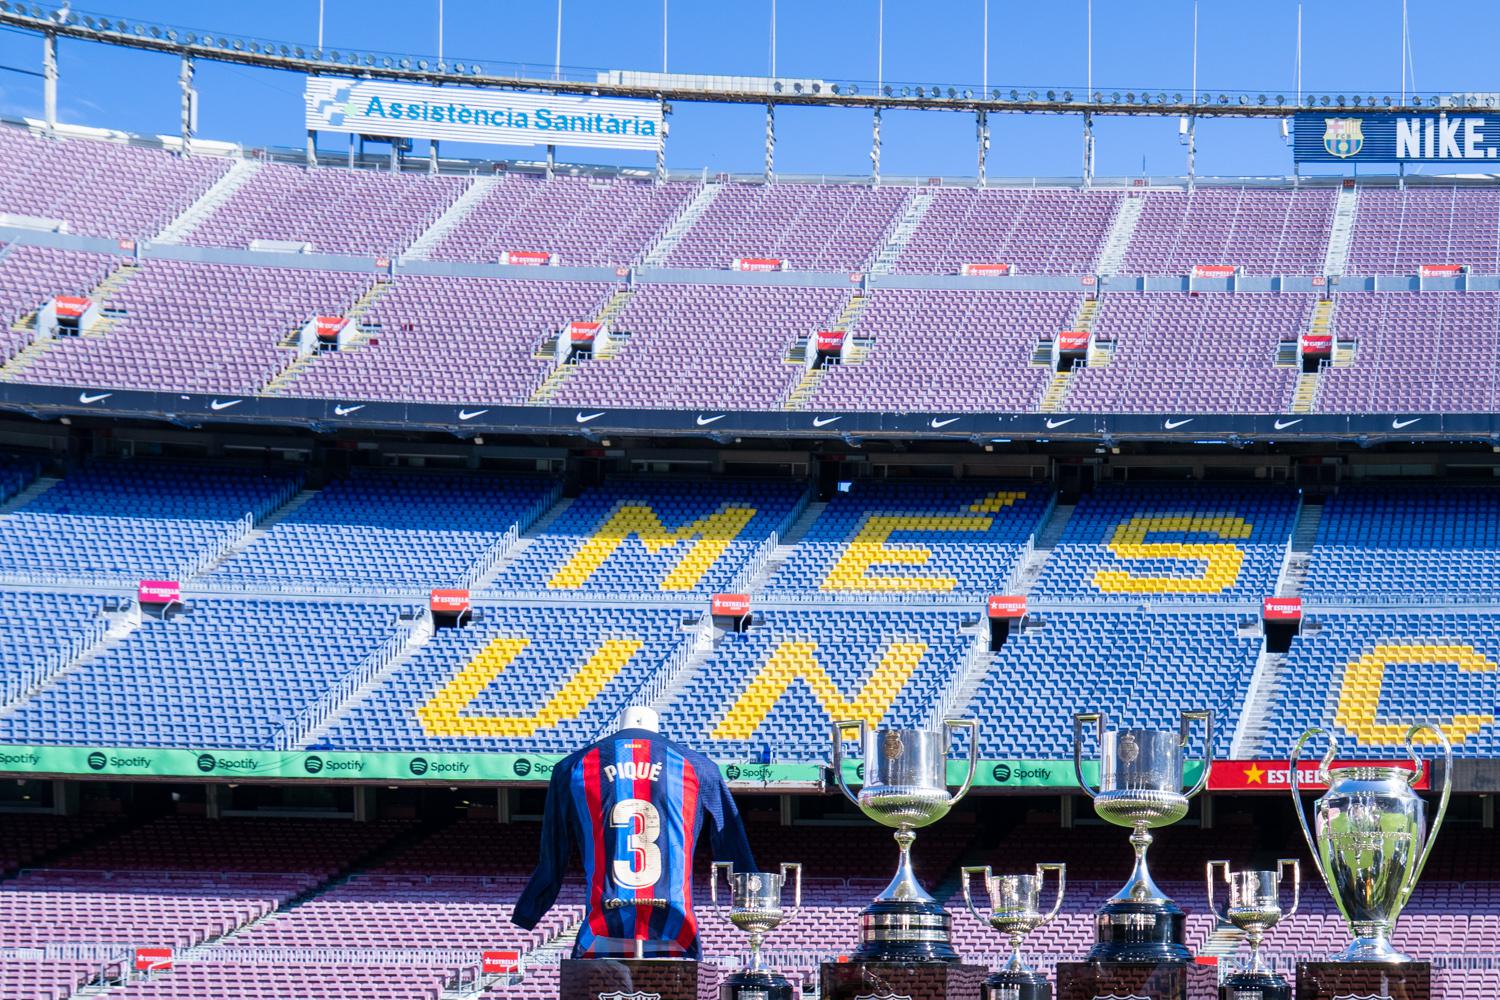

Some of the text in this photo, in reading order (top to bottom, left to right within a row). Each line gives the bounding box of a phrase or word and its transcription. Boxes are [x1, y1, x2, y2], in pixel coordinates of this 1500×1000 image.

[365, 96, 656, 137] Assistència Sanitària
[547, 491, 1255, 593] MÉS
[417, 636, 929, 741] UN
[110, 755, 151, 769] Spotify
[218, 757, 258, 770] Spotify
[326, 759, 364, 772] Spotify
[430, 761, 470, 774] Spotify
[603, 761, 663, 783] PIQUÉ
[1013, 767, 1052, 780] Spotify
[1267, 769, 1323, 784] ESTREL
[609, 798, 662, 890] 3
